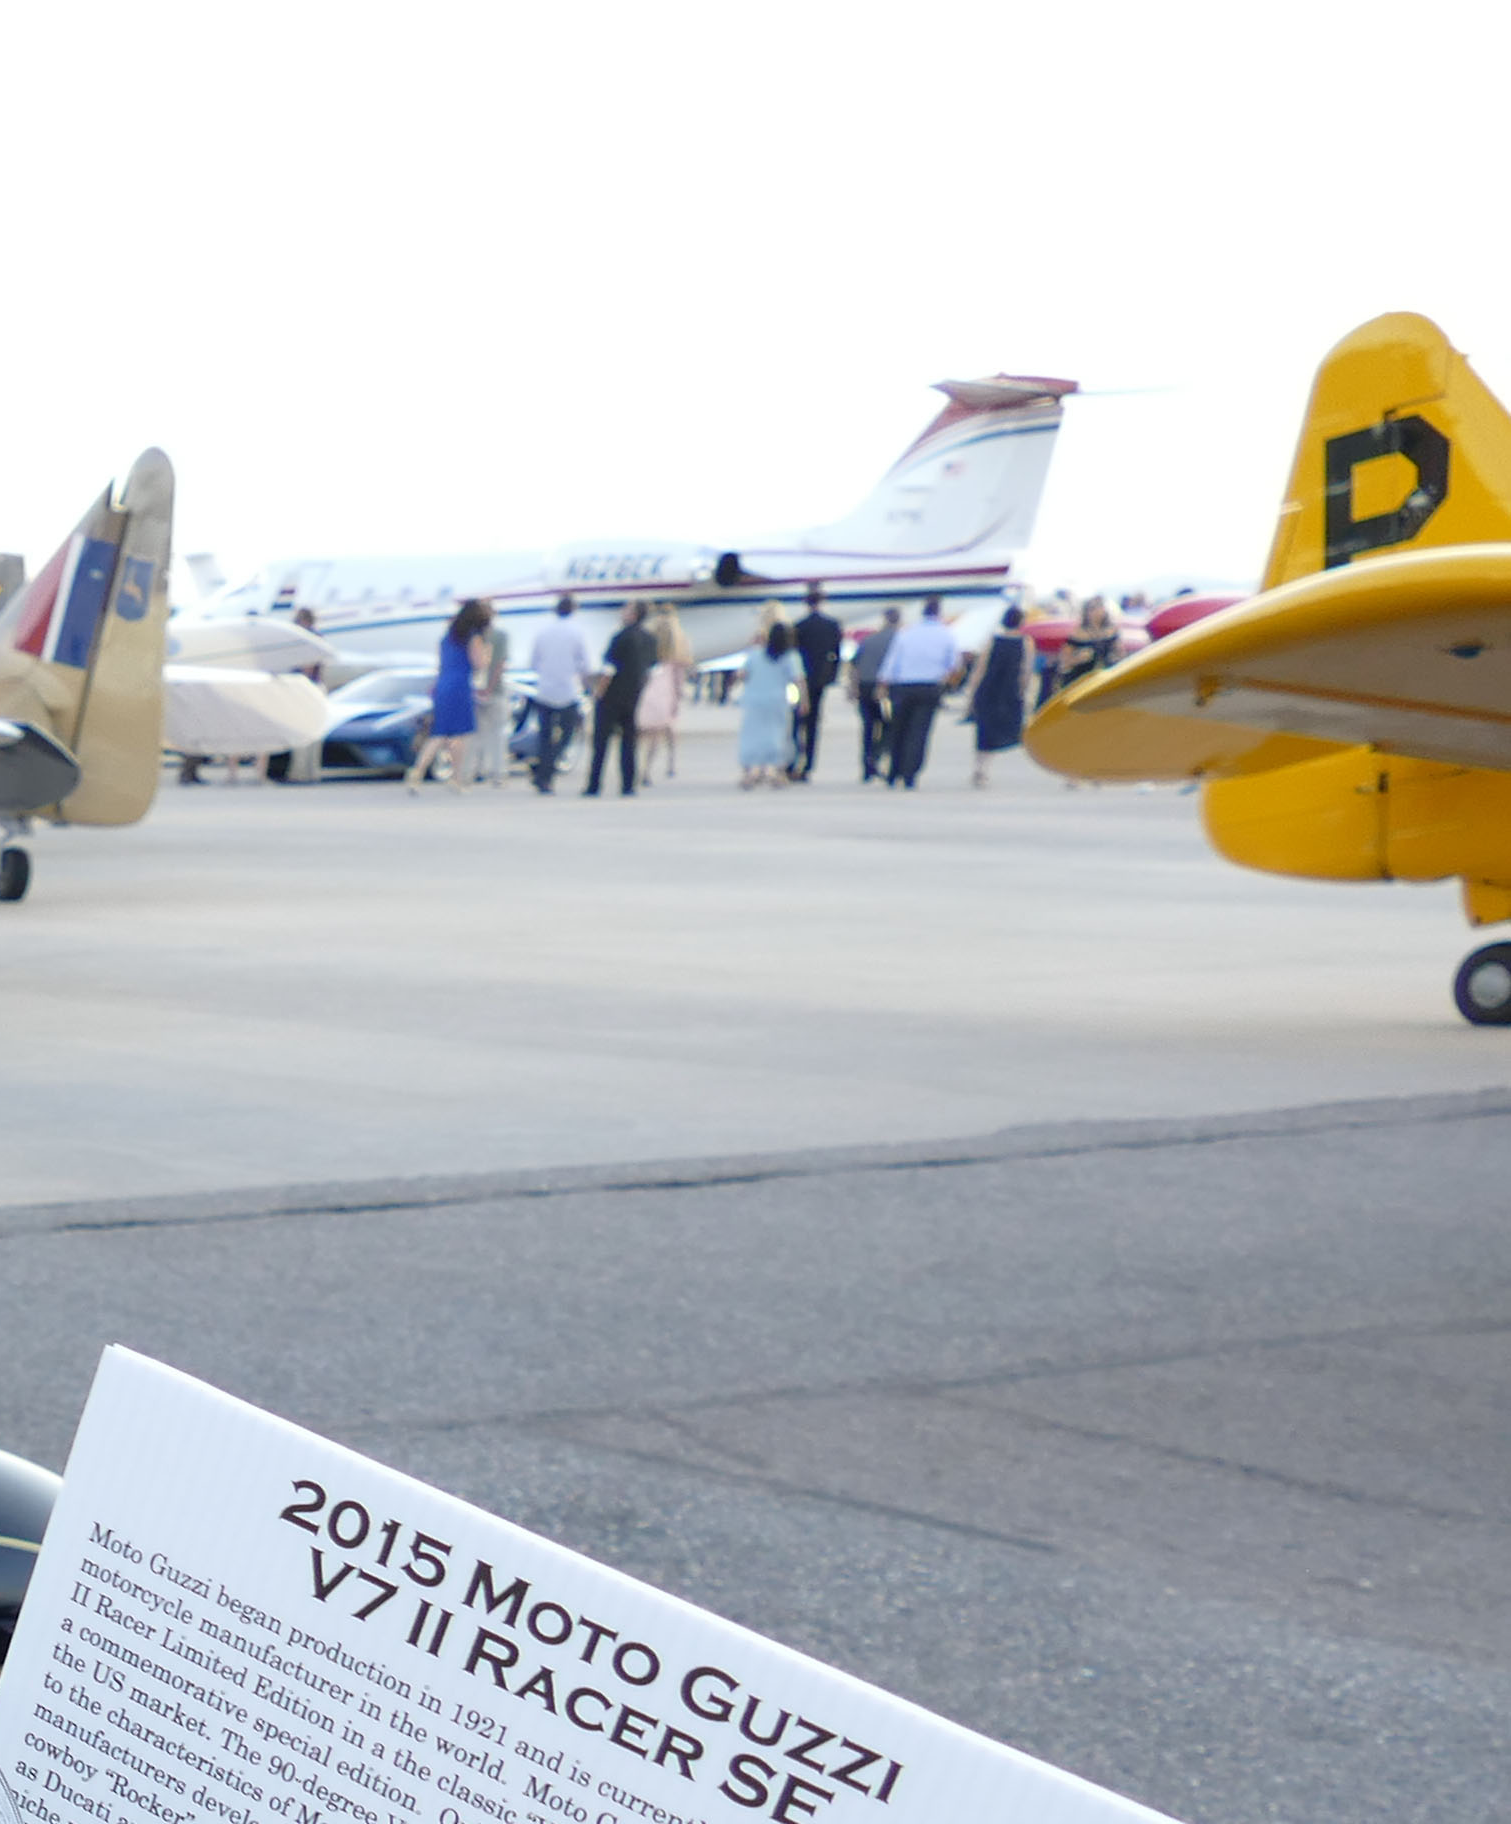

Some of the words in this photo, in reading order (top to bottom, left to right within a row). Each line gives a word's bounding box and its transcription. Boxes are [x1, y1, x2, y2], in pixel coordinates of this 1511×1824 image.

[1325, 415, 1450, 570] P
[51, 1642, 86, 1673] the
[92, 1658, 127, 1693] US
[126, 1685, 211, 1741] market.
[219, 1726, 262, 1766] The
[69, 1580, 93, 1608] II
[92, 1592, 158, 1641] Racer
[158, 1626, 248, 1689] Limited
[250, 1672, 335, 1735] Edition
[392, 1747, 431, 1782] the
[78, 1626, 248, 1724] commemorative
[251, 1716, 333, 1768] special
[335, 1760, 422, 1816] edition.
[79, 1557, 193, 1625] motorcycle
[196, 1617, 355, 1706] manufacturer
[388, 1708, 428, 1743] the
[435, 1735, 507, 1785] world.
[521, 1774, 588, 1823] Moto
[88, 1520, 143, 1565] Moto
[148, 1552, 213, 1600] Guzzi
[215, 1583, 282, 1636] began
[284, 1626, 412, 1700] production
[416, 1685, 442, 1716] in
[448, 1703, 508, 1747] 1921
[513, 1740, 564, 1775] and
[277, 1479, 454, 1588] 2015
[460, 1558, 661, 1687] MOTO
[679, 1665, 904, 1805] GUZZI
[309, 1545, 400, 1622] V7
[404, 1597, 455, 1658] II
[461, 1625, 705, 1782] RACER
[14, 1760, 39, 1782] as
[40, 1768, 114, 1824] Ducati
[23, 1731, 99, 1783] cowboy
[32, 1702, 187, 1796] manufacturers
[67, 1683, 102, 1716] the
[105, 1706, 264, 1803] characteristics
